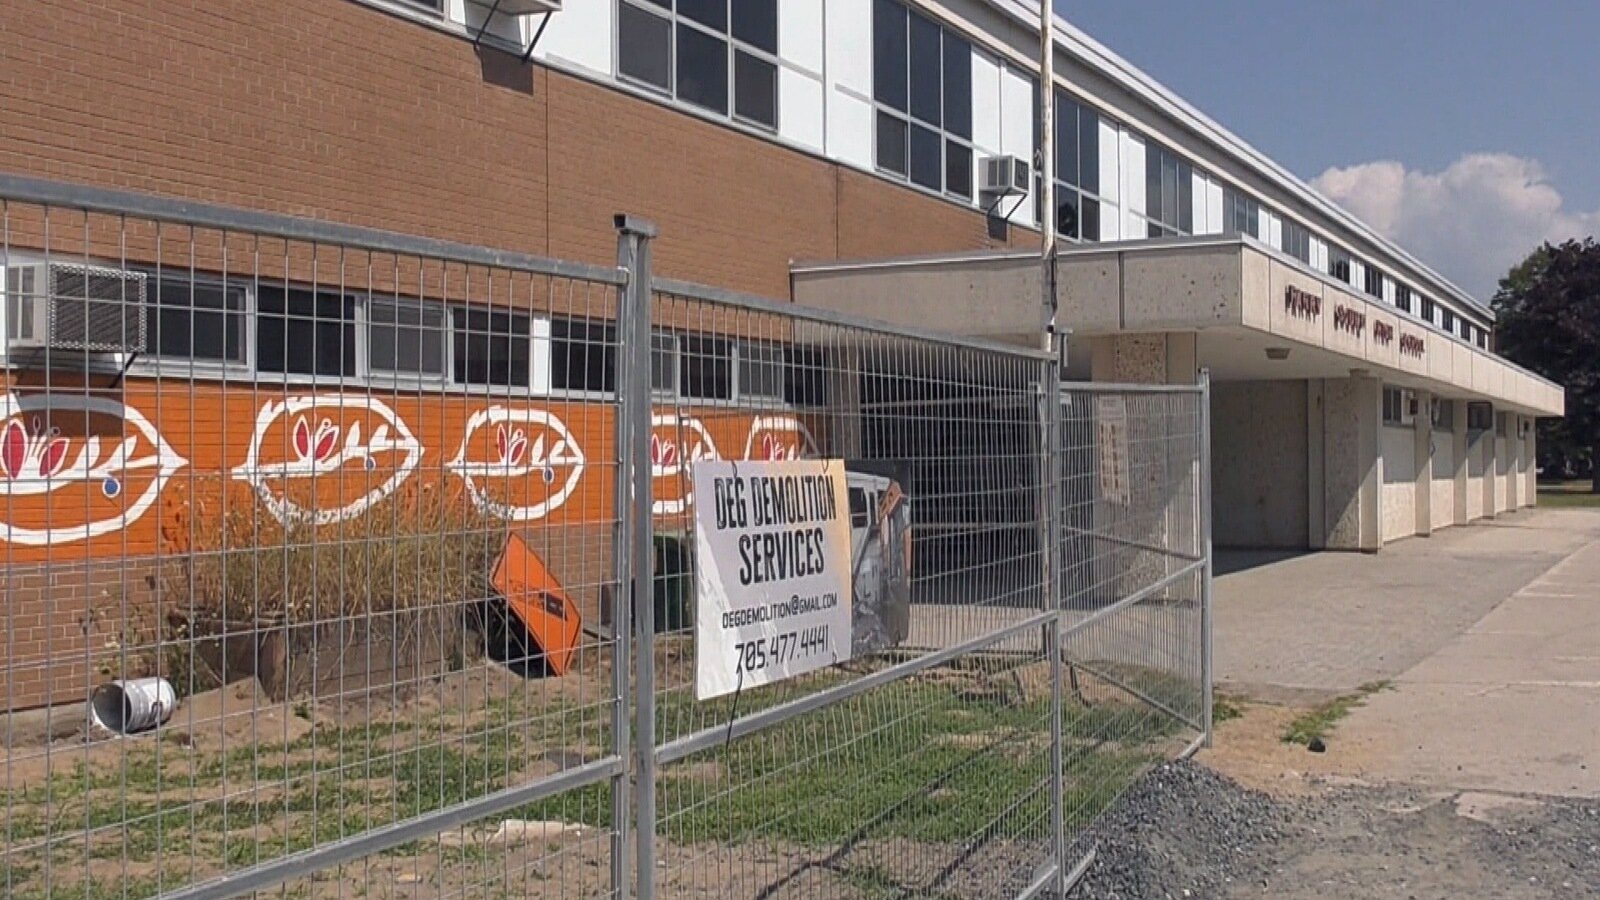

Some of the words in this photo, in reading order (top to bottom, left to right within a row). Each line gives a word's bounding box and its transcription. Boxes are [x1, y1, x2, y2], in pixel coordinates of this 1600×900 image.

[714, 477, 748, 530] DEG
[751, 475, 836, 526] DEMOLITION
[739, 528, 824, 586] SERVICES
[722, 592, 838, 628] DEGDEMOLITION@GMAIL.COM
[734, 625, 829, 675] 705.477.4441
